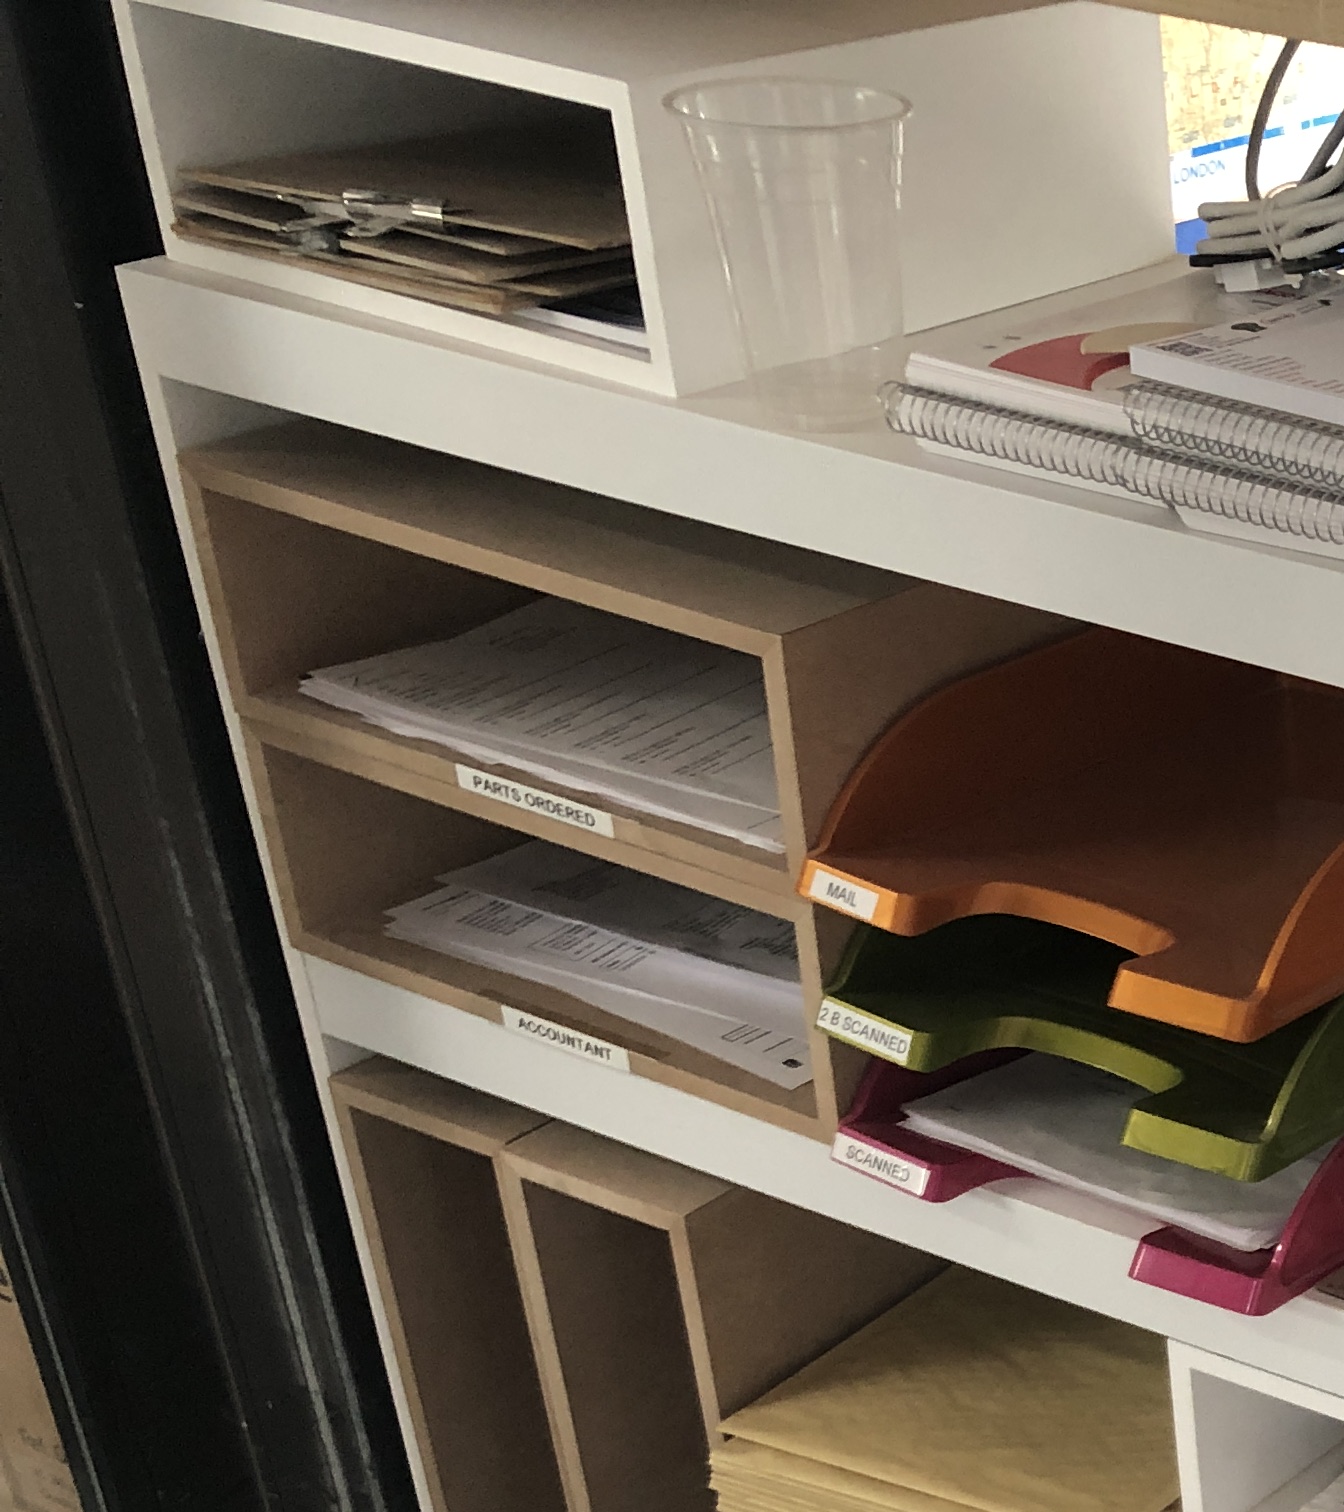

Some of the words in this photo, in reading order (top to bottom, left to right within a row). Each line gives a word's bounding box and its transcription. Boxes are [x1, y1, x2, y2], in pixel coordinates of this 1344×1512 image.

[1173, 159, 1226, 184] LONDON
[471, 775, 523, 803] PARTS
[524, 792, 596, 827] ORDERED
[826, 882, 857, 908] MAIL
[517, 1017, 613, 1061] ACCOUNTANT
[819, 1007, 830, 1023] 2
[829, 1012, 840, 1027] B
[841, 1015, 909, 1055] SCANNED
[845, 1145, 911, 1183] SCANNED
